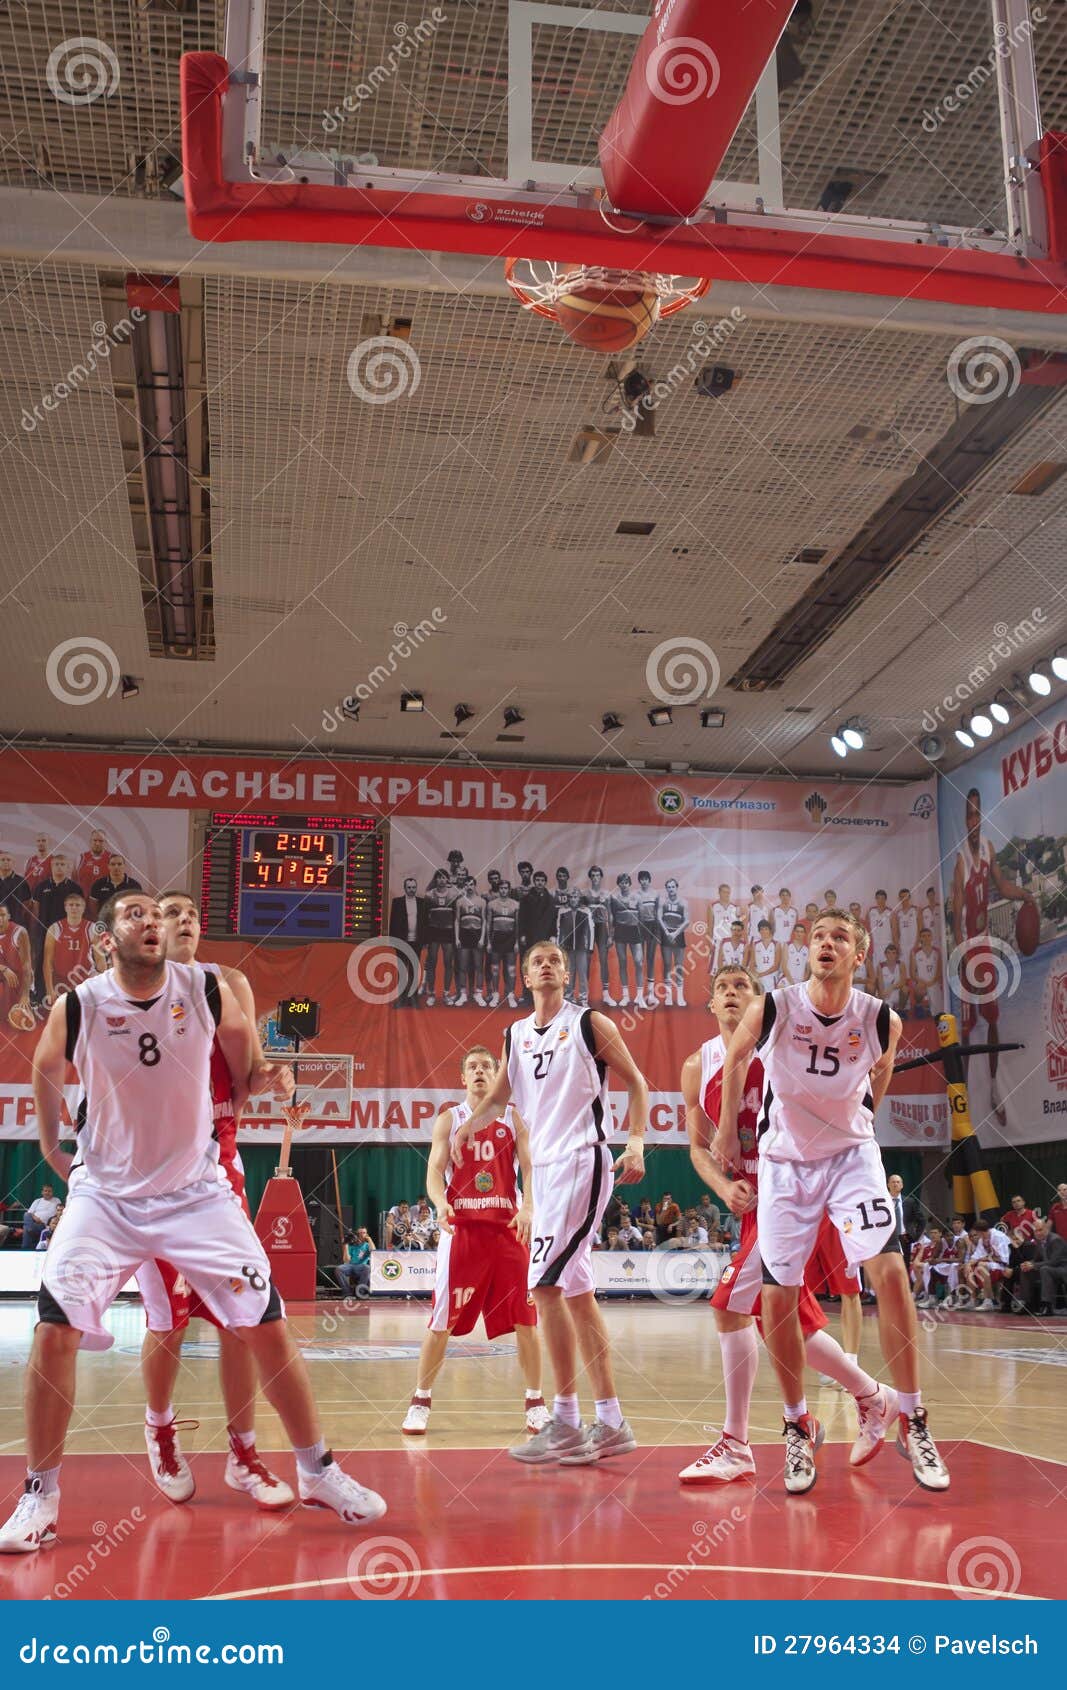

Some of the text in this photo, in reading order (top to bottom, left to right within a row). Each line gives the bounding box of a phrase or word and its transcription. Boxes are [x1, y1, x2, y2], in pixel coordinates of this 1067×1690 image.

[107, 767, 547, 811] КРАСНЫЕ КРЫЛЬЯ
[691, 796, 777, 811] Тольяттиазот
[824, 816, 888, 828] РОСНЕФТЬ
[277, 833, 324, 852] 2:04
[253, 851, 261, 862] 3
[289, 862, 297, 872] 3
[326, 854, 333, 865] 5
[258, 865, 282, 883] 41
[303, 867, 328, 884] 65
[288, 1003, 310, 1013] 2:04
[138, 1032, 161, 1066] 8
[533, 1050, 553, 1080] 27
[806, 1044, 840, 1077] 15
[472, 1139, 496, 1162] 10
[856, 1198, 892, 1231] 15
[531, 1235, 554, 1264] 27
[241, 1265, 267, 1291] 8
[452, 1286, 476, 1310] 10
